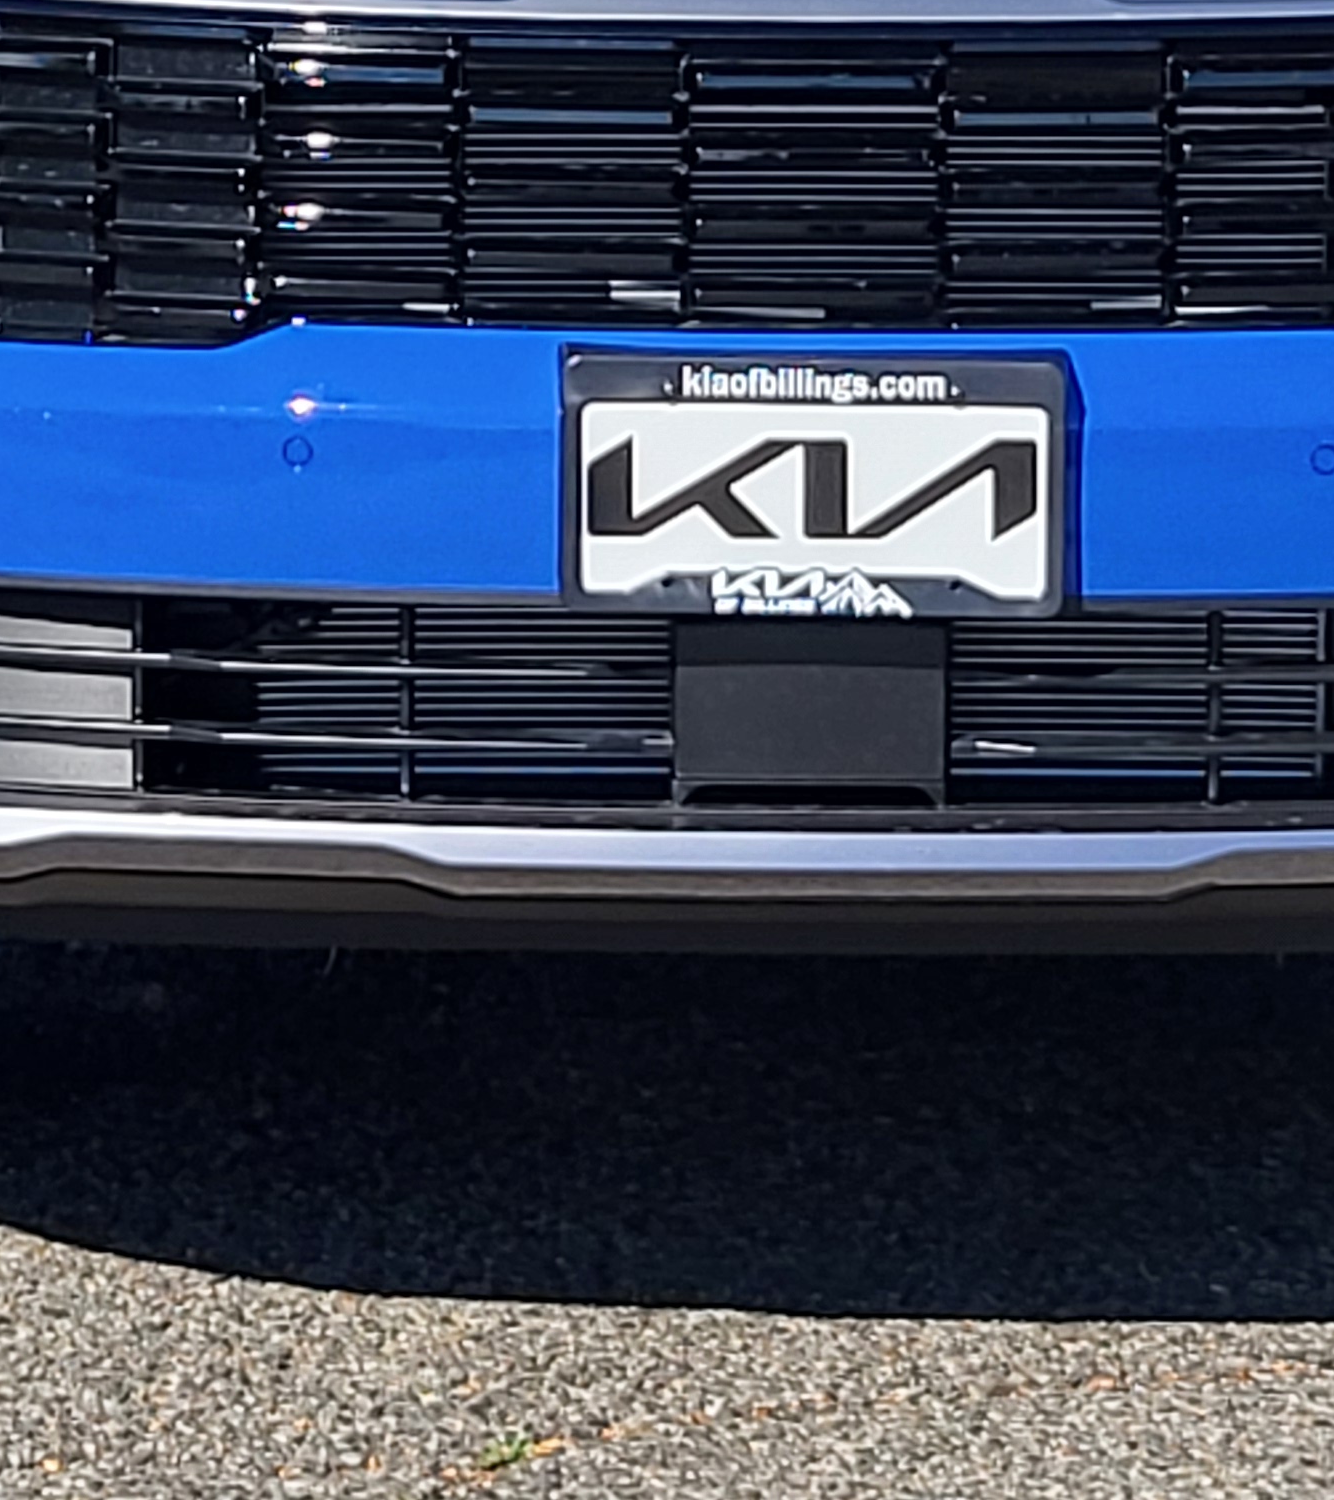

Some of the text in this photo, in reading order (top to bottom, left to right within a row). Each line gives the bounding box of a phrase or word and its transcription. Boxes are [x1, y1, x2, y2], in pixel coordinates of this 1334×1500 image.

[682, 365, 947, 403] kiaofbillings.com
[587, 436, 1038, 541] KIA
[712, 569, 825, 598] KIA
